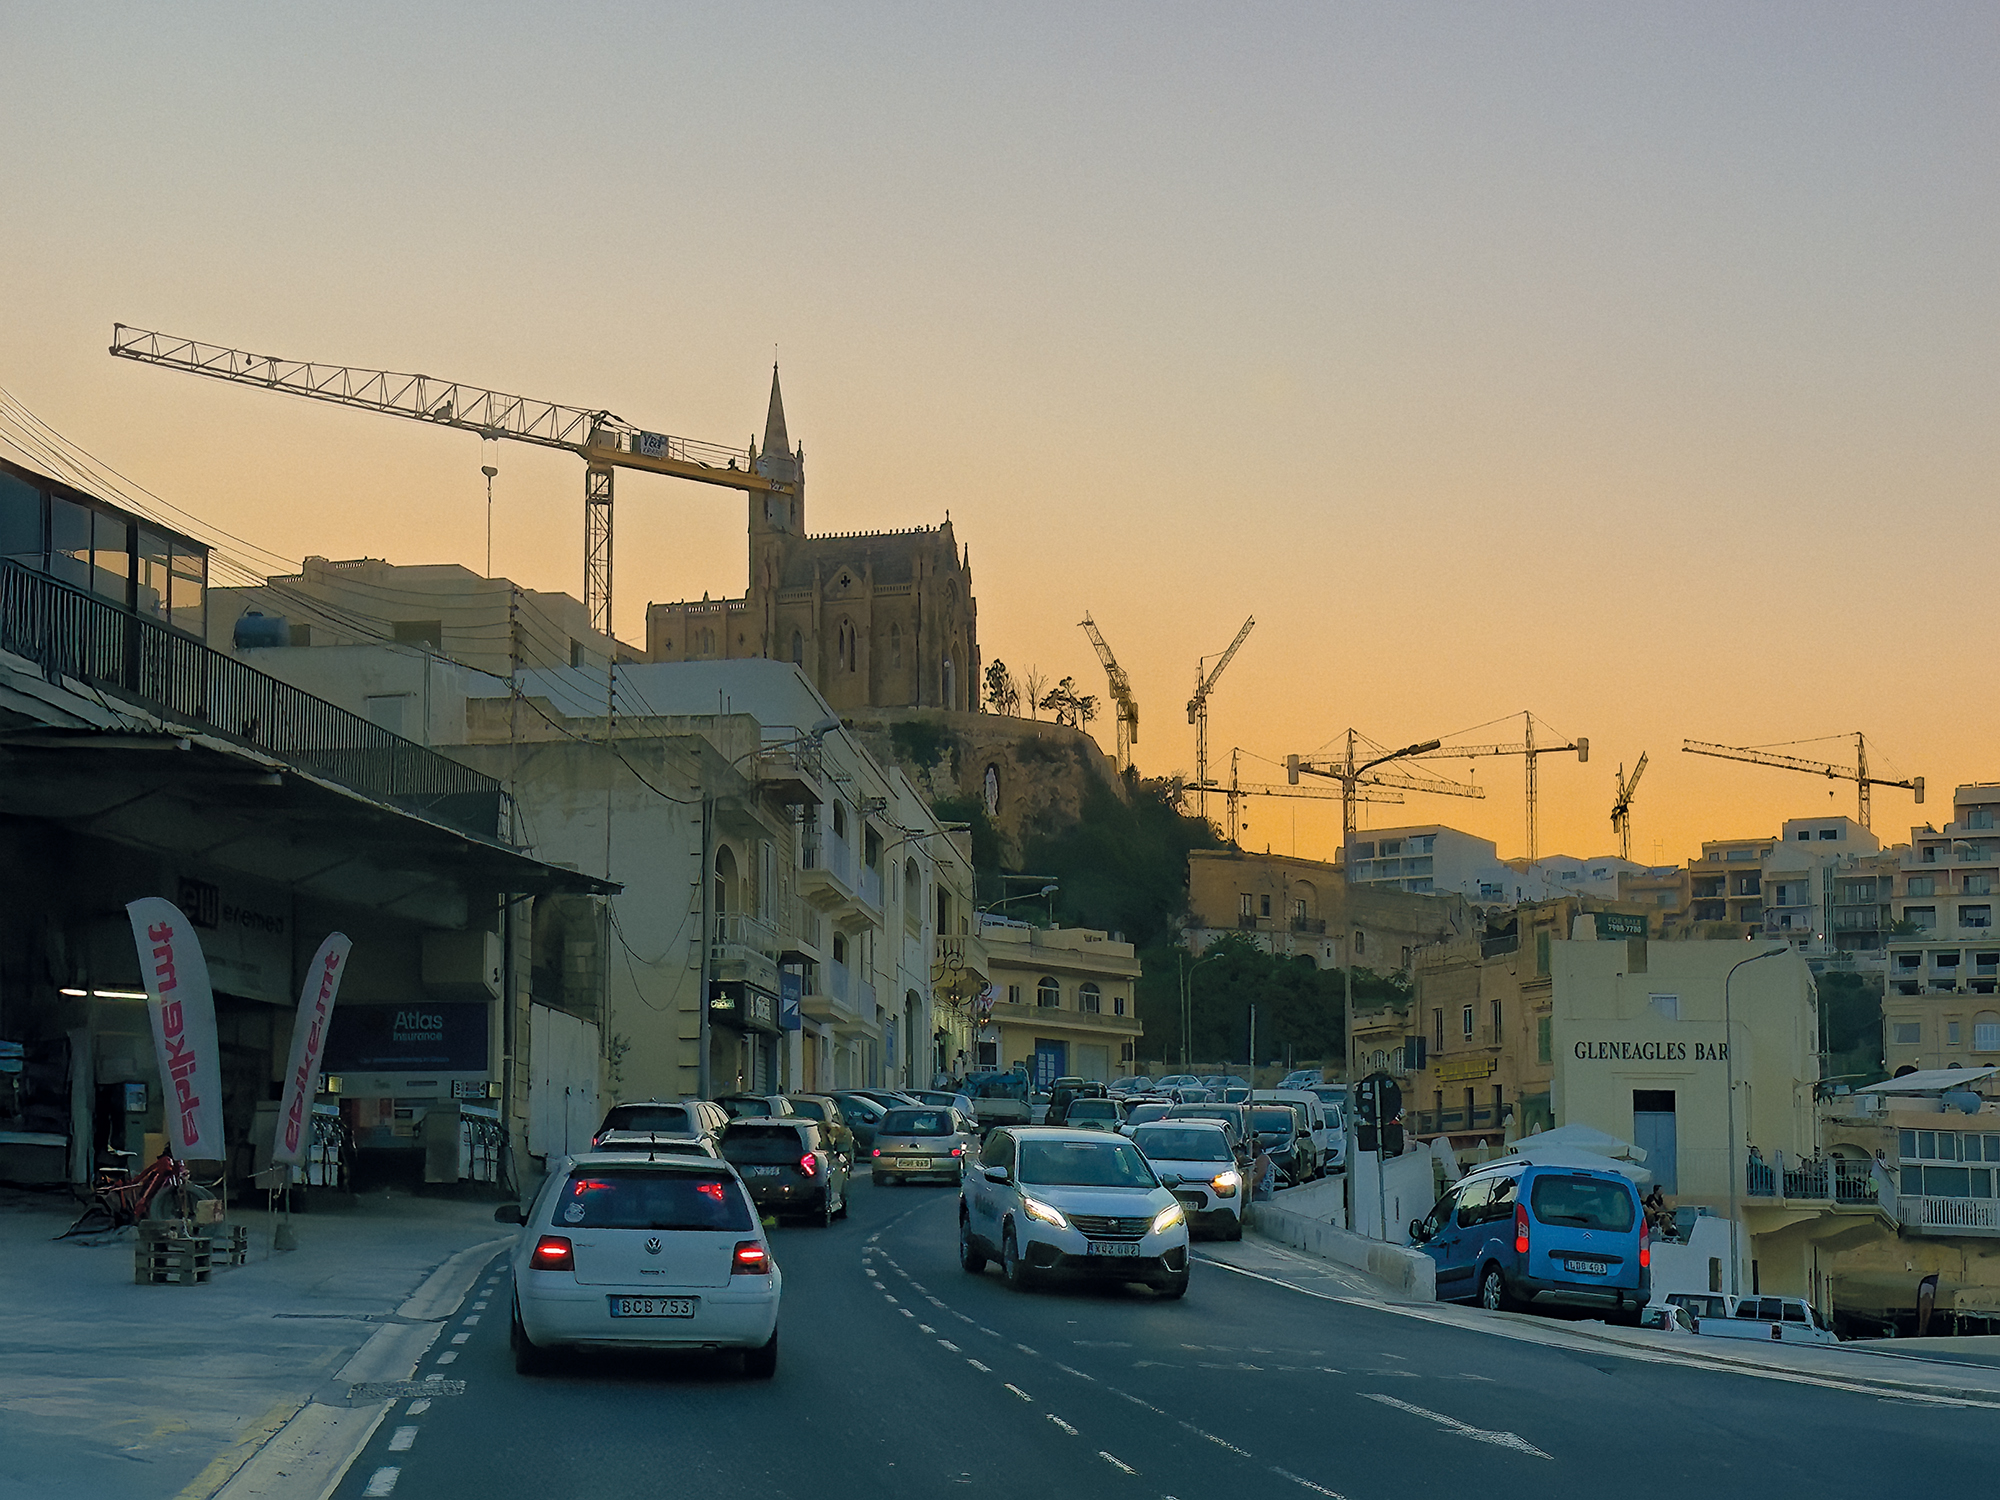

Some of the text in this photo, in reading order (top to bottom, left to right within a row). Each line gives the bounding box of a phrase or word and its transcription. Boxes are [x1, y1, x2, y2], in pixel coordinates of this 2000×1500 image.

[393, 1011, 443, 1030] Atlas
[393, 1032, 443, 1041] Insurance
[285, 950, 340, 1153] ebike.mt
[1574, 1041, 1728, 1060] GLENEAGLES BAR
[621, 1301, 690, 1313] BCB 753
